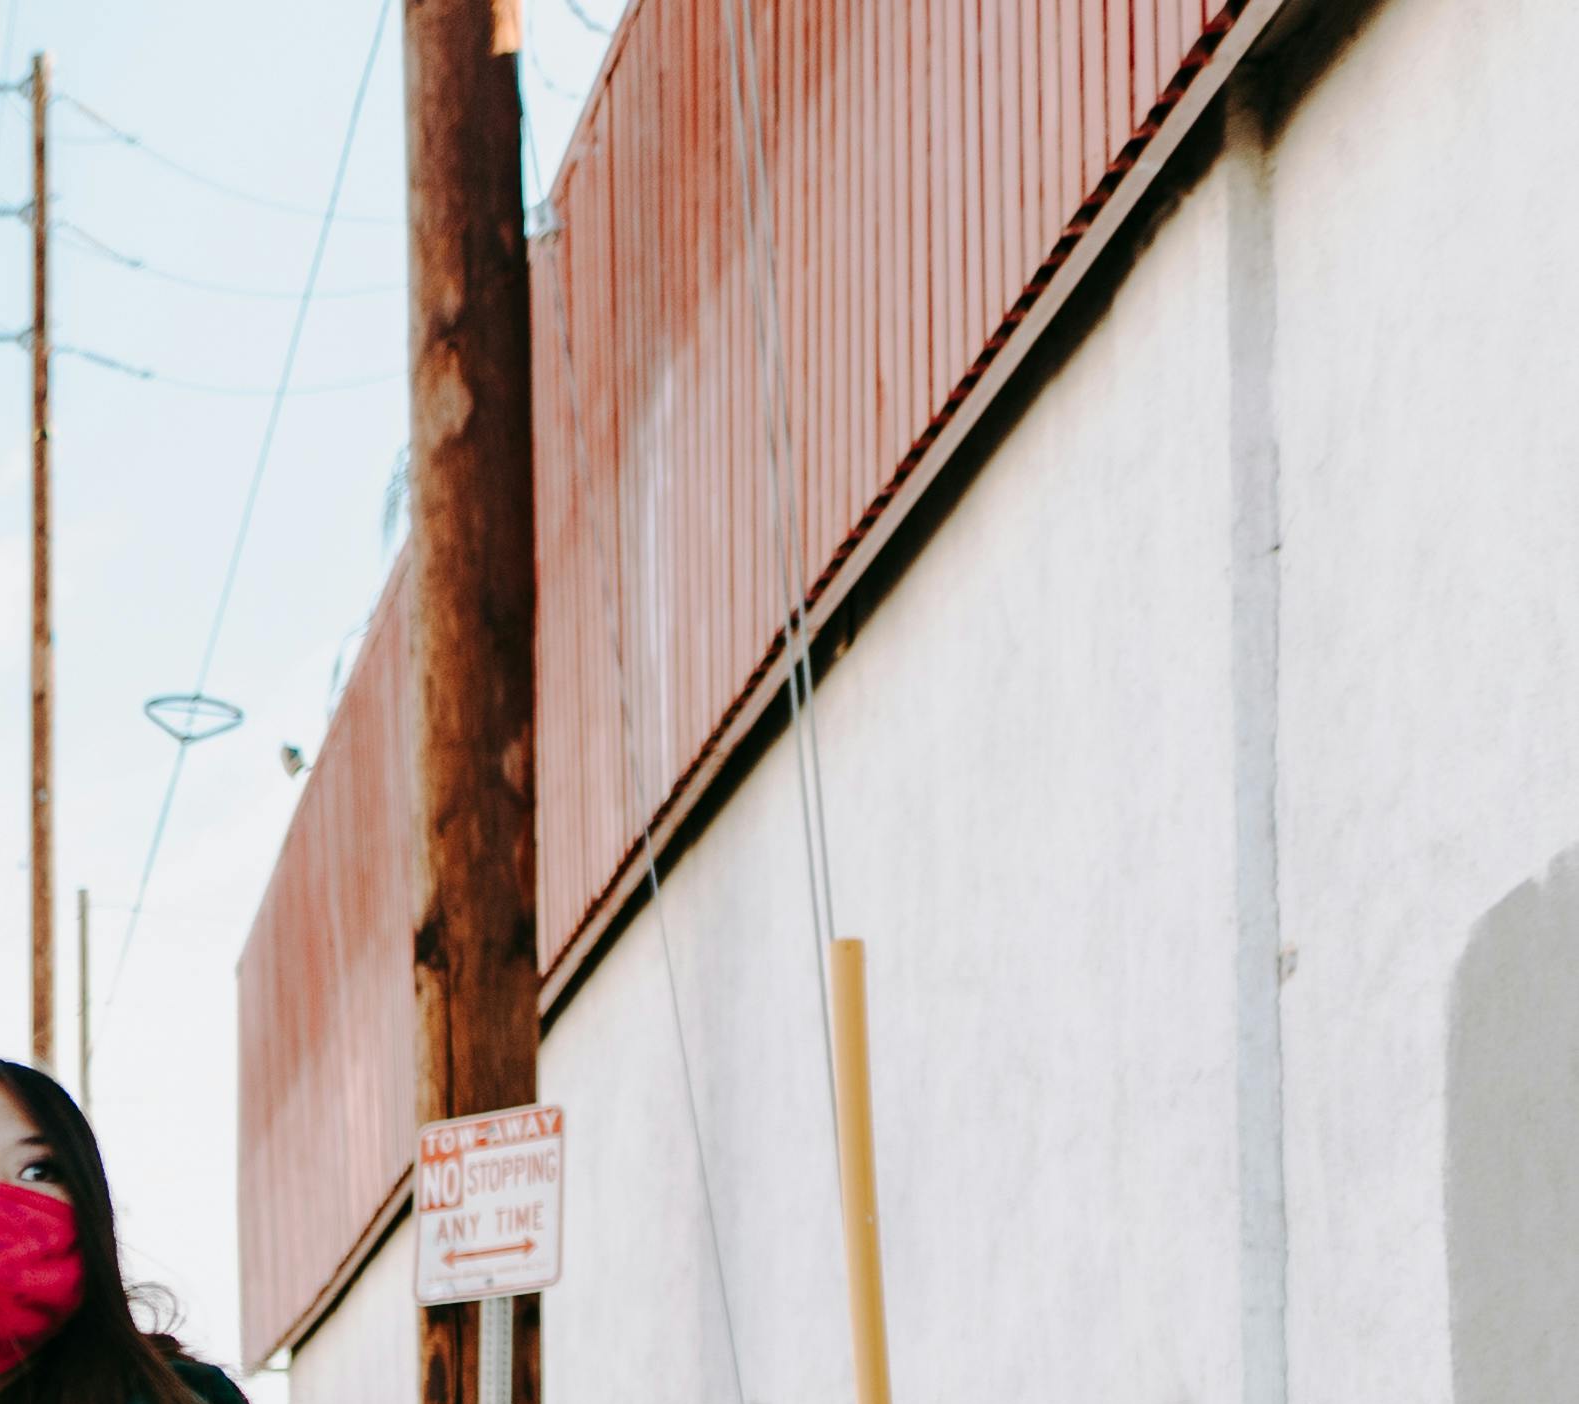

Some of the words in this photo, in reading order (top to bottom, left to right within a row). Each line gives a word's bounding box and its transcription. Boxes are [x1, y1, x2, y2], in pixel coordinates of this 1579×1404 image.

[424, 1111, 558, 1156] TOW-AWAY
[422, 1158, 461, 1210] NO
[466, 1148, 557, 1196] STOPPING
[435, 1211, 481, 1246] ANY
[495, 1201, 545, 1236] TIME
